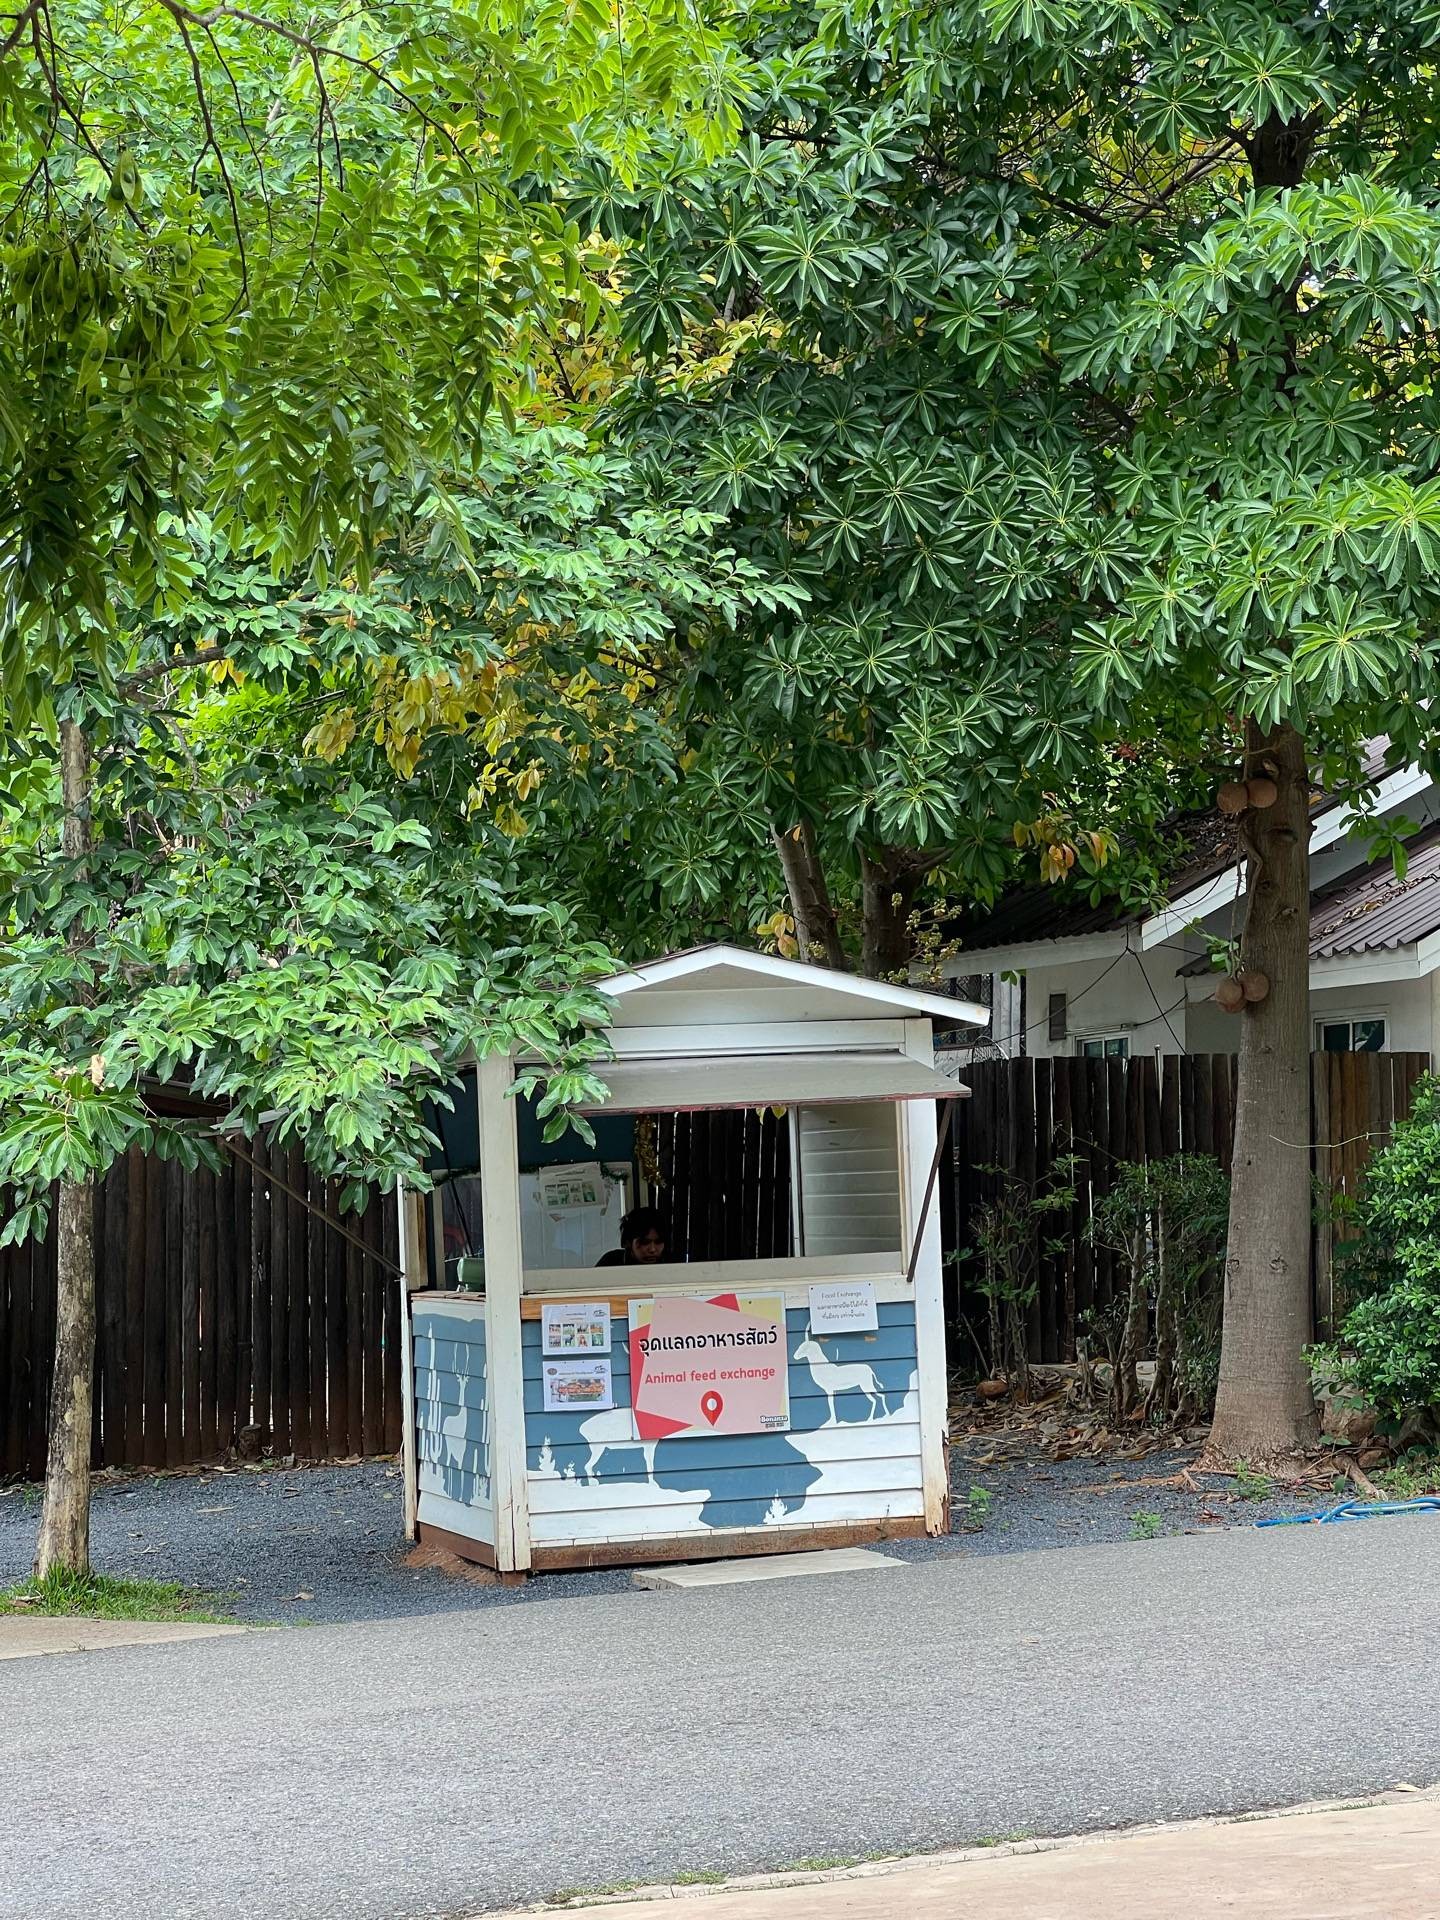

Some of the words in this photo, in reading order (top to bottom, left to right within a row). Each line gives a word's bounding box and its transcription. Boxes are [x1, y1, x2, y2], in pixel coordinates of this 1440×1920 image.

[640, 1325, 778, 1357] จุดแลกอาหารสัตว์
[645, 1372, 686, 1385] Animal
[690, 1370, 717, 1382] feed
[720, 1368, 776, 1381] exchange
